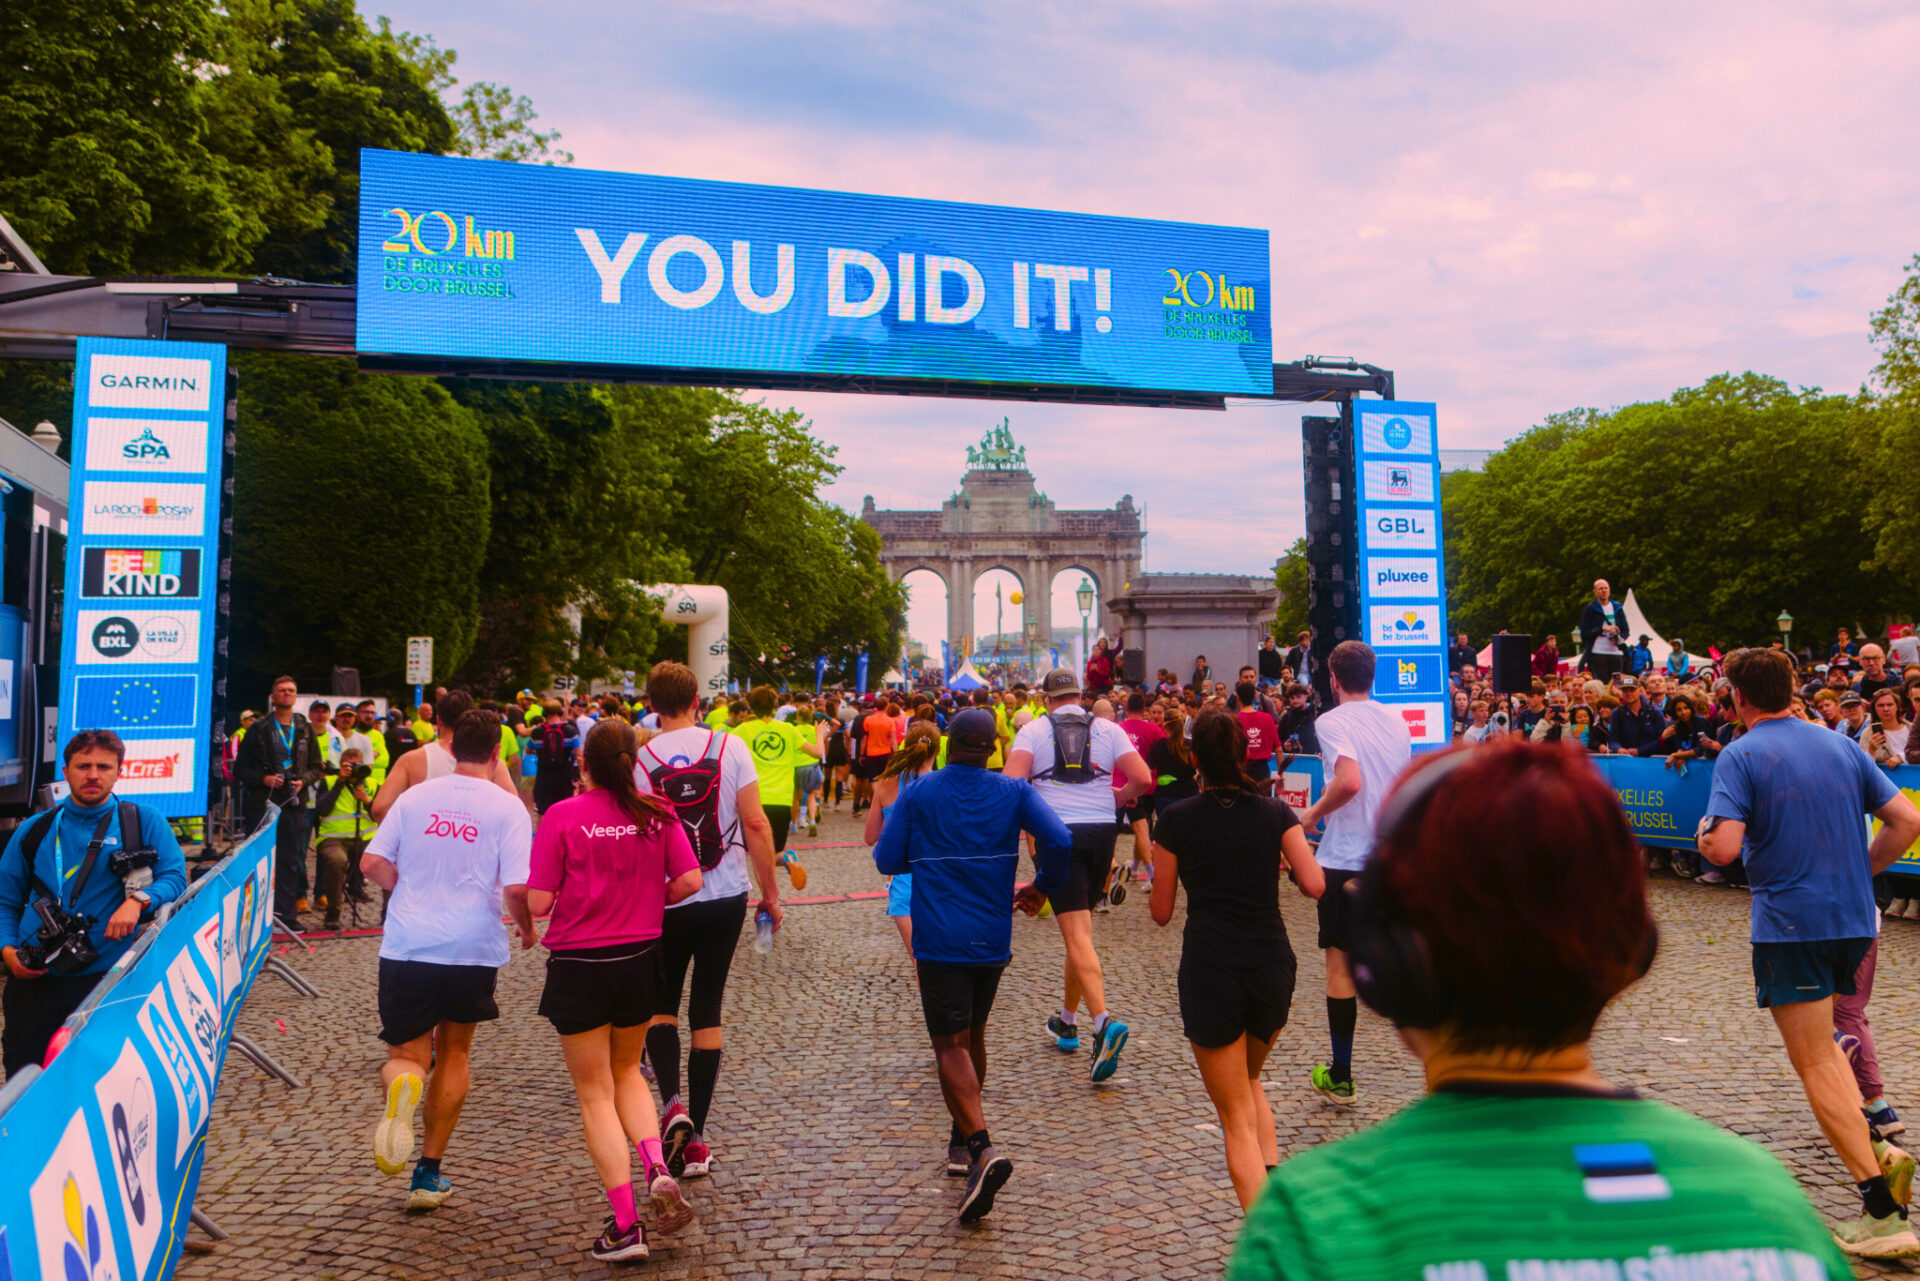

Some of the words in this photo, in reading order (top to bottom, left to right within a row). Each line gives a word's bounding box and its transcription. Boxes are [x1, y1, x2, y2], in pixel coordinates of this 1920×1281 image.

[382, 208, 458, 255] 20
[465, 215, 516, 260] km
[383, 256, 408, 272] DE
[412, 258, 503, 279] BRUXELLES
[383, 275, 441, 293] DOOR
[445, 279, 516, 299] BRUSSEL
[574, 228, 796, 315] YOU
[827, 247, 986, 325] DID
[1013, 261, 1113, 334] IT!
[1161, 268, 1215, 309] 20
[1219, 273, 1256, 312] km
[1163, 309, 1181, 323] DE
[1184, 311, 1247, 328] BRUXELLES
[1163, 325, 1205, 340] DOOR
[1207, 328, 1257, 345] BRUSSEL
[100, 374, 197, 392] GARMIN
[122, 443, 171, 460] SPA
[1377, 517, 1425, 534] GBL
[102, 573, 181, 596] KIND
[1377, 568, 1429, 587] pluxee
[676, 601, 698, 614] SPA
[99, 635, 132, 649] BXL
[709, 644, 728, 656] SP
[1398, 658, 1417, 673] be
[553, 677, 576, 690] SP
[708, 678, 727, 690] SP
[1398, 672, 1417, 685] EU
[1615, 788, 1664, 807] XELLES
[1624, 810, 1678, 829] RUSSEL
[581, 823, 645, 840] Veepe
[195, 1008, 217, 1063] SPA
